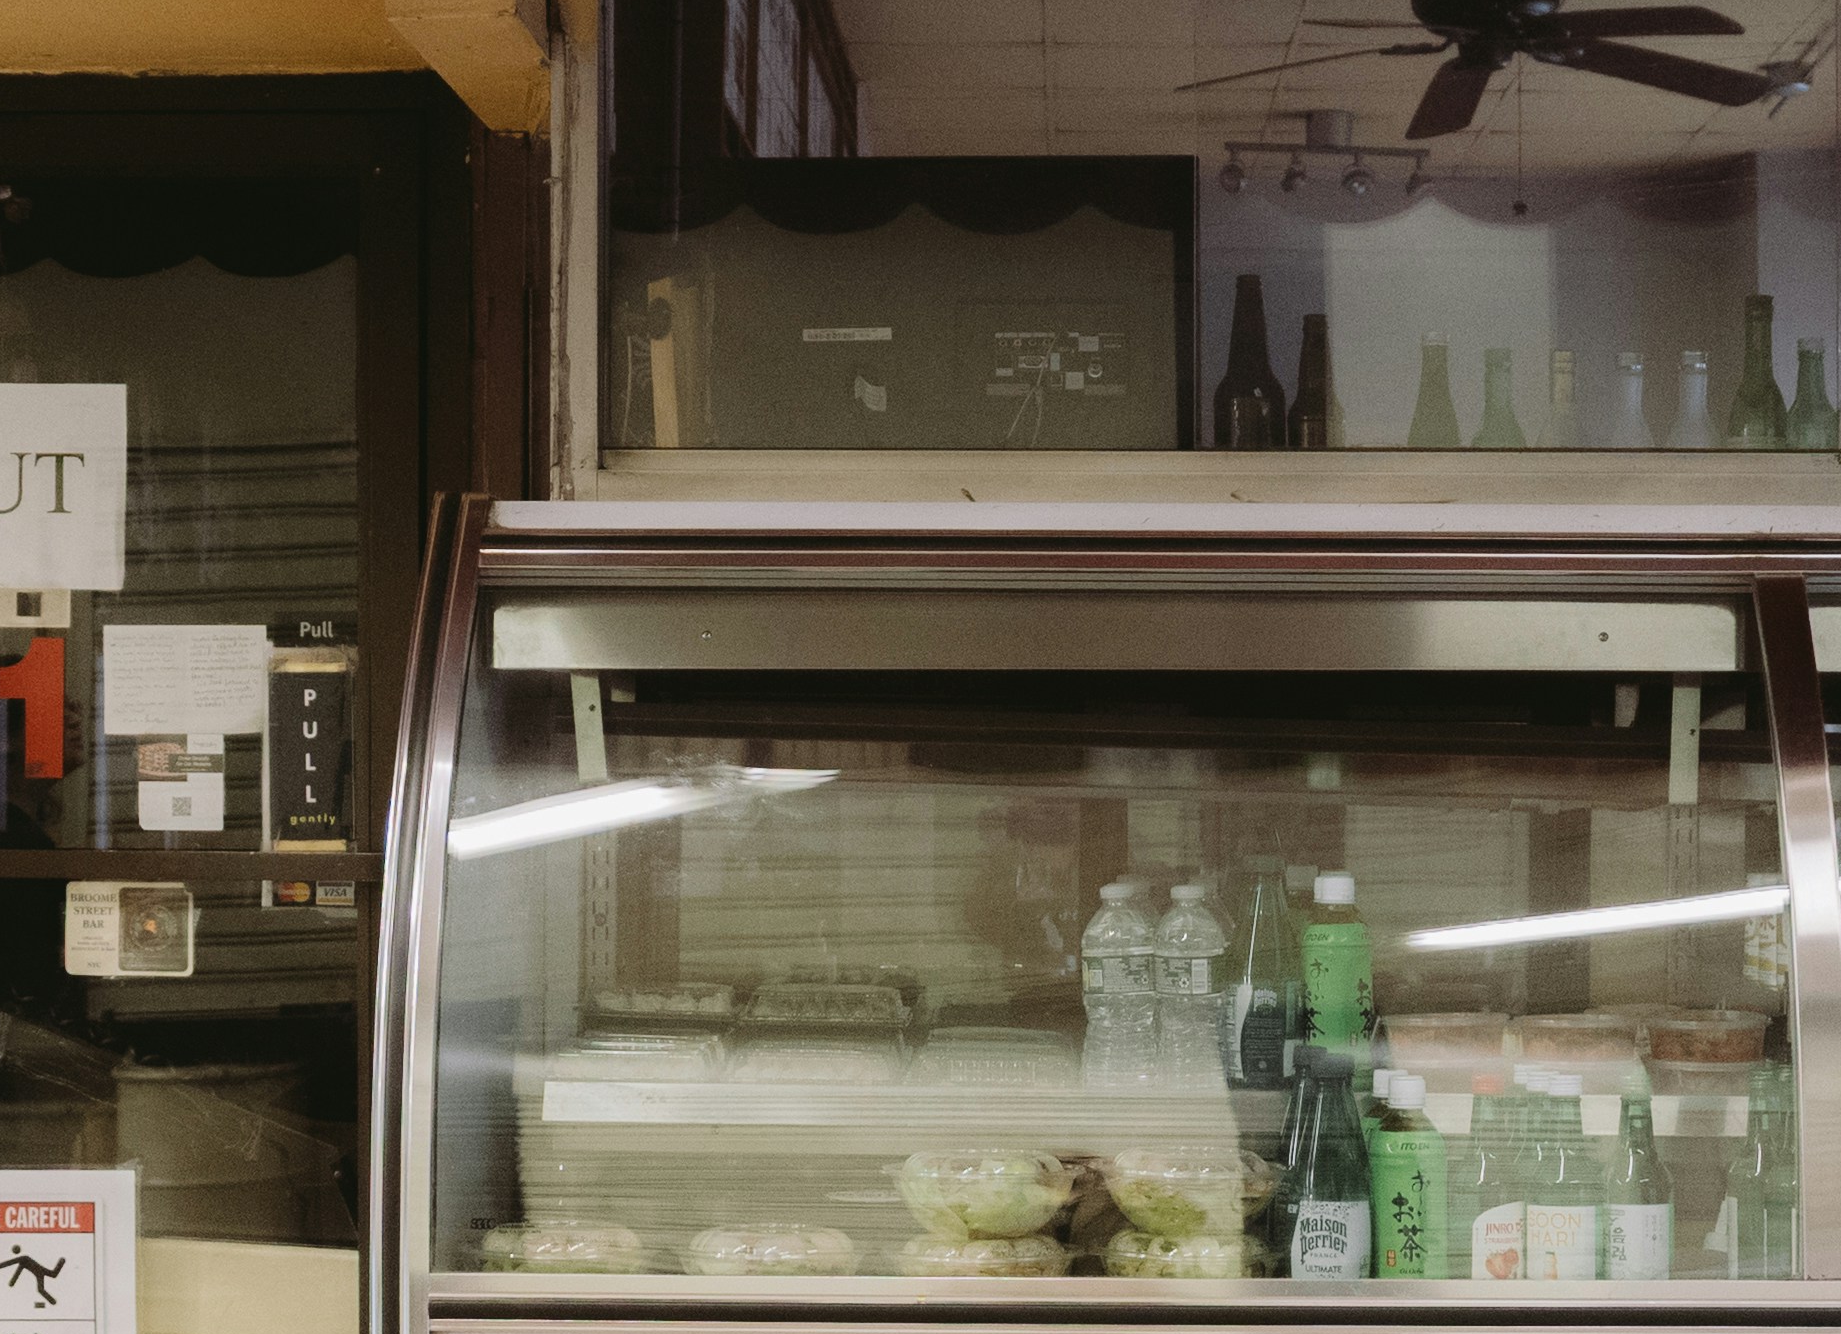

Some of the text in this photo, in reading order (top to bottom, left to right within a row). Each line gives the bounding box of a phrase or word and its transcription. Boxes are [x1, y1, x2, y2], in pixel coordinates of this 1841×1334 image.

[299, 621, 334, 638] Pull
[302, 688, 318, 804] PULL
[289, 813, 336, 826] gently
[70, 893, 118, 903] BROOME
[323, 887, 348, 897] VISA
[72, 906, 113, 916] STREET
[82, 919, 105, 928] BAR
[4, 1206, 80, 1229] CAREFUL
[1300, 1214, 1348, 1239] Maison
[1391, 1191, 1428, 1263] お茶
[1485, 1222, 1515, 1236] JINRO
[1305, 1264, 1343, 1273] ULTIMATE
